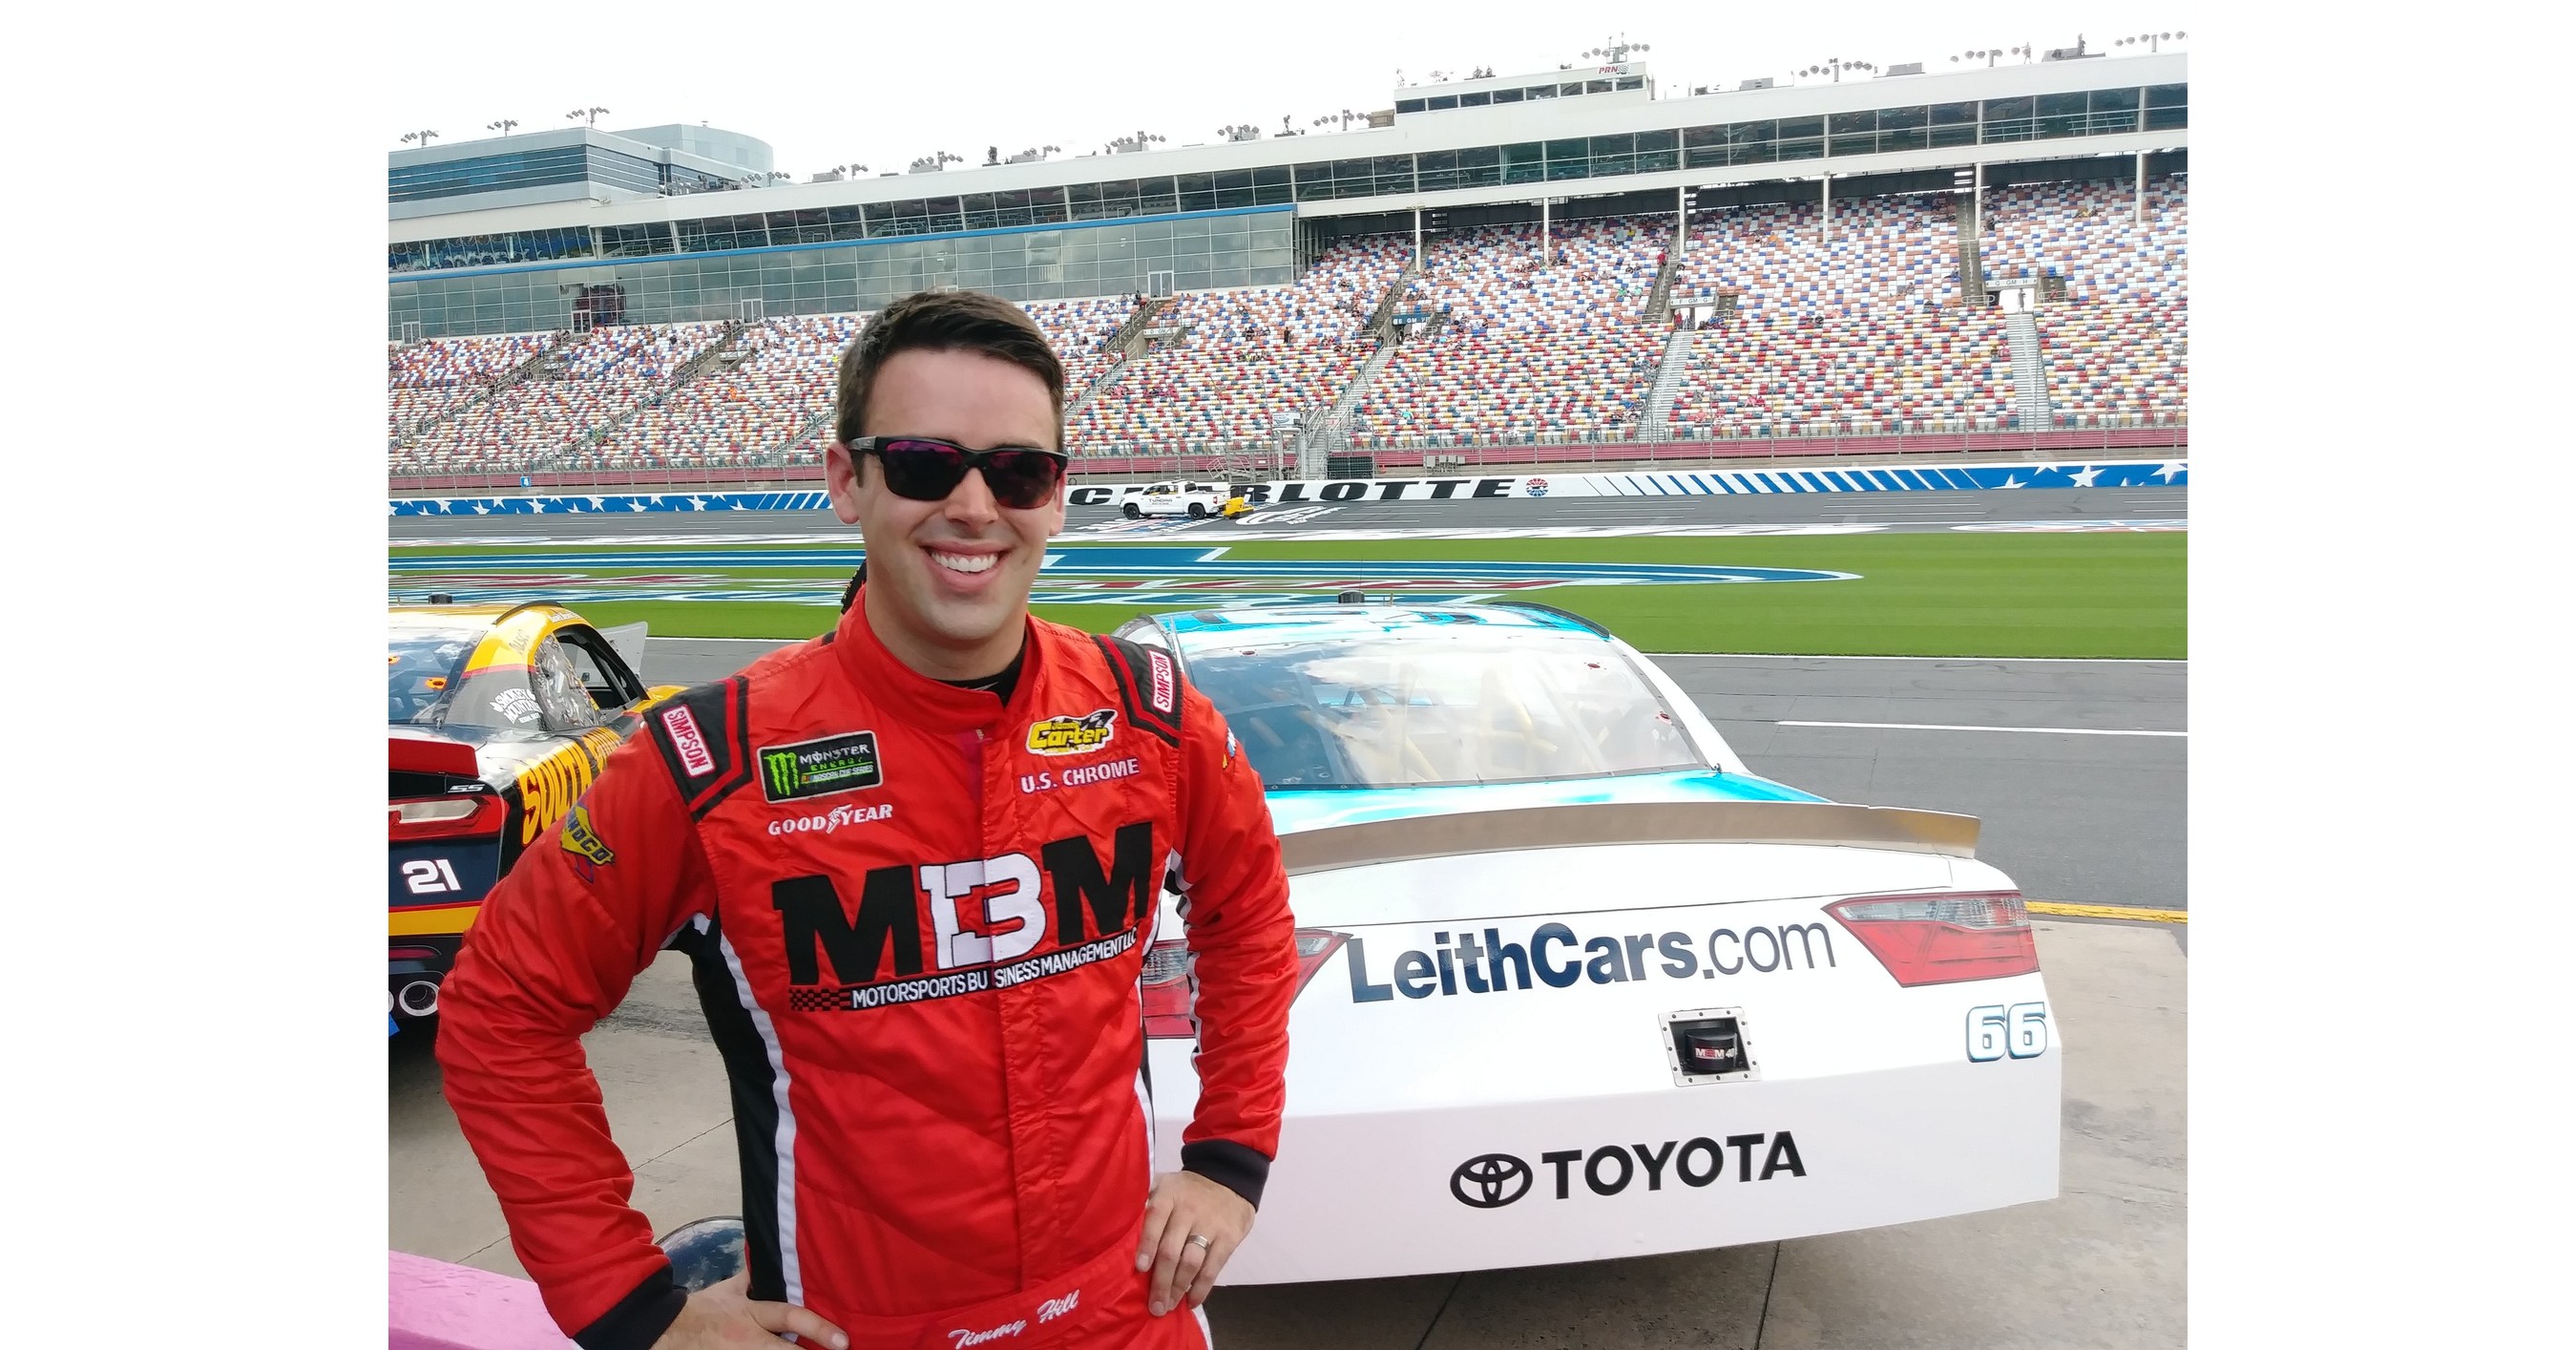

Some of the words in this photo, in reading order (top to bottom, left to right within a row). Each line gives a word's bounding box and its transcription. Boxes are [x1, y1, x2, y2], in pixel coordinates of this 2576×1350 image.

[1598, 66, 1619, 74] PRN
[1068, 478, 1516, 505] CRLOTTE
[494, 687, 531, 709] SMOKEY
[1152, 654, 1170, 708] SIMPSON
[667, 710, 709, 770] SIMPSON
[1029, 721, 1109, 749] Carter
[810, 756, 863, 771] ENERGY
[1020, 772, 1058, 793] U.S.
[1062, 758, 1141, 786] CHROME
[402, 859, 462, 894] 21
[1350, 921, 1837, 1003] LeithCars.com
[852, 972, 966, 1009] MOTORSPORTS
[1966, 1002, 2047, 1063] 66
[1540, 1130, 1807, 1200] TOYOTA
[948, 1318, 1027, 1350] Timmy
[1037, 1289, 1079, 1324] Hill
